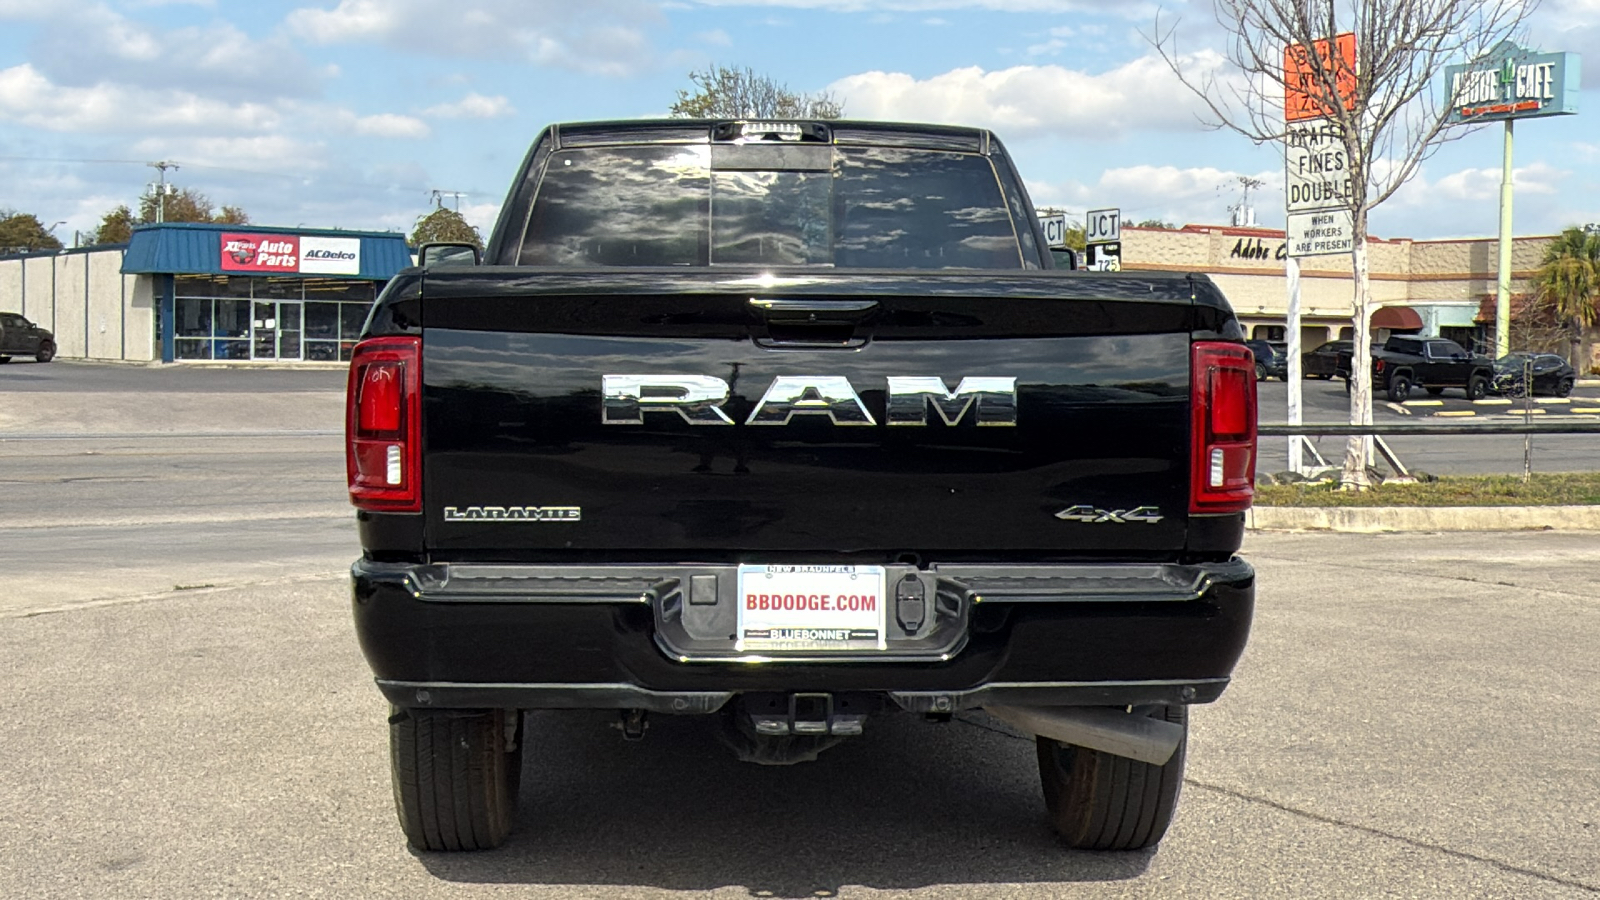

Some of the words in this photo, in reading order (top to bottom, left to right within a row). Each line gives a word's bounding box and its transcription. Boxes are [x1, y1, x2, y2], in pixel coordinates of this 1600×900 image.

[1516, 62, 1555, 99] CAFE
[1299, 151, 1344, 176] FINES
[1291, 178, 1353, 204] DOUBLE
[1088, 214, 1117, 238] JCT
[1311, 215, 1335, 226] WHEN
[1303, 227, 1343, 239] WORKERS
[257, 239, 294, 254] Auto
[1230, 238, 1270, 260] Adobe
[1295, 242, 1312, 252] ARE
[1314, 239, 1352, 251] PRESENT
[256, 252, 297, 267] Parts
[305, 249, 356, 260] ACDelco
[602, 374, 1018, 427] RAM
[444, 506, 581, 522] LARAMIE
[746, 594, 877, 612] BBDODGE.COM
[770, 629, 851, 641] BLUEBONNET
